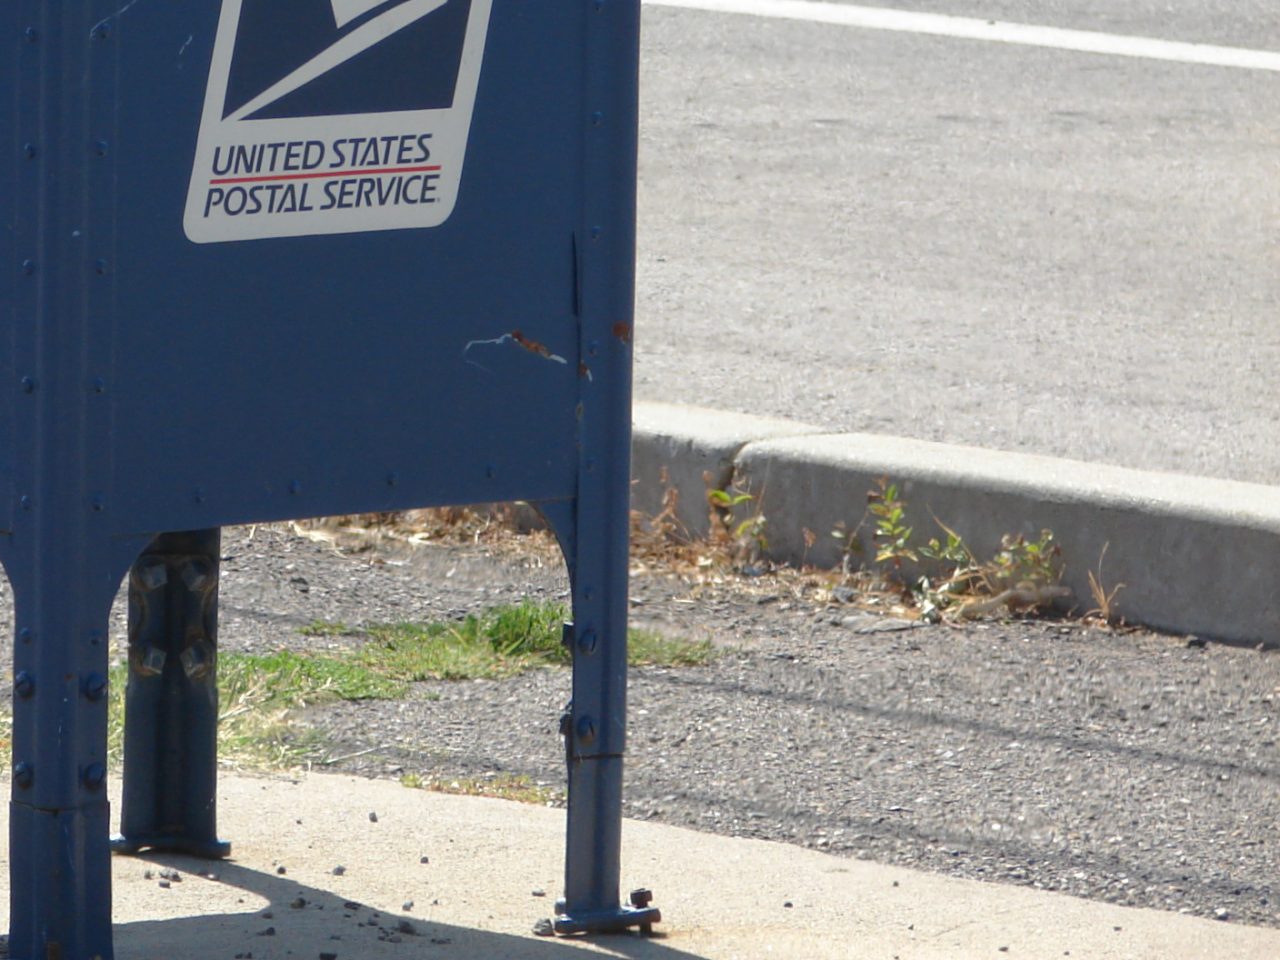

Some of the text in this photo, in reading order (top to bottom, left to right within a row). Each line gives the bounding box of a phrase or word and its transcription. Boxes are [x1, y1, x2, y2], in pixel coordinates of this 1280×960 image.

[212, 133, 433, 175] UNITED STATES
[203, 183, 313, 218] POSTAL
